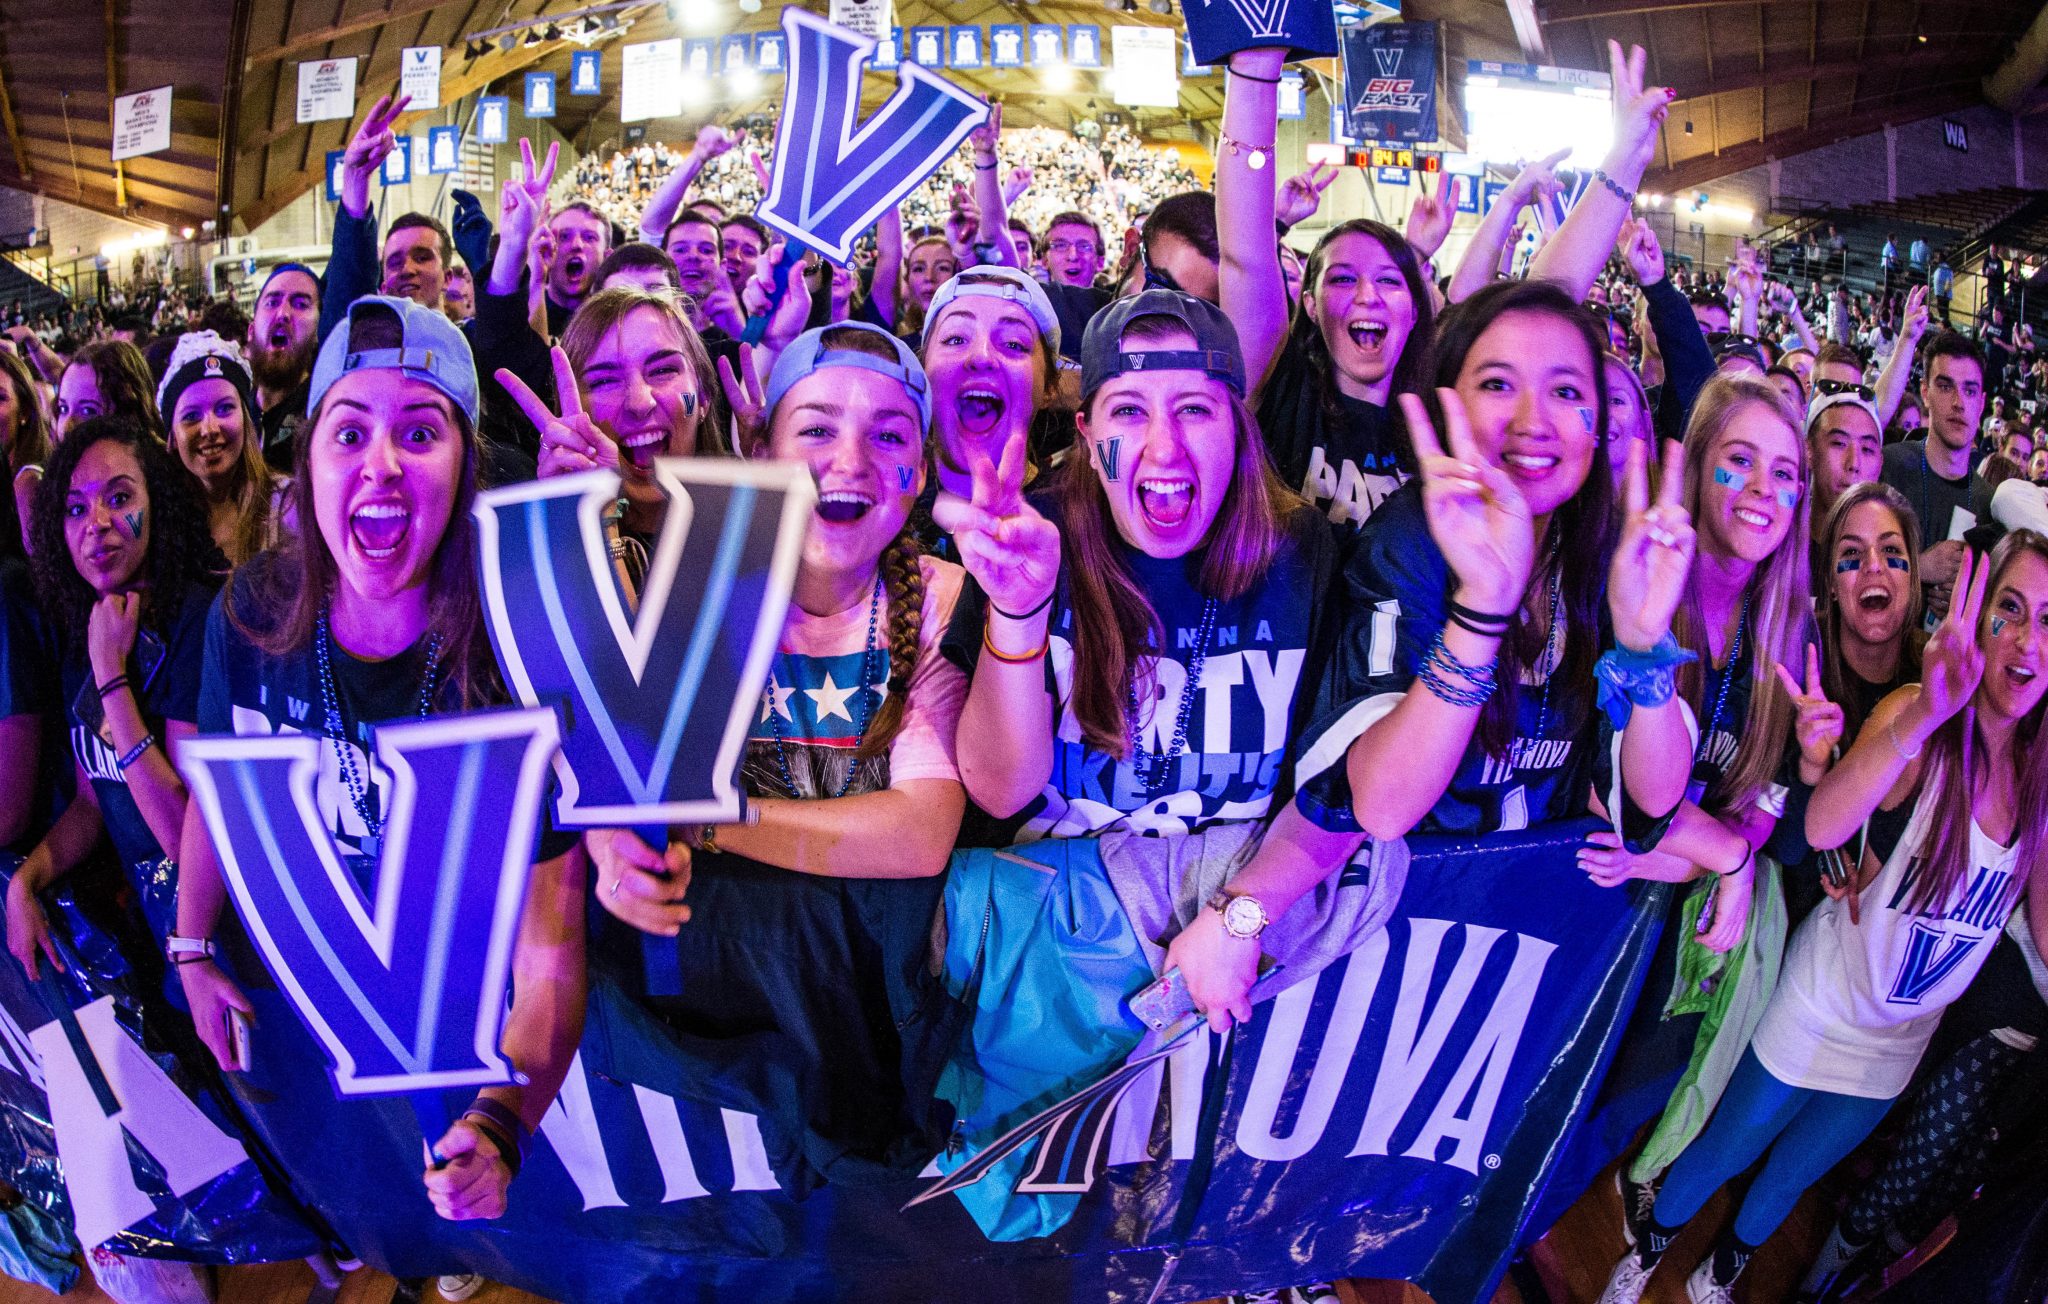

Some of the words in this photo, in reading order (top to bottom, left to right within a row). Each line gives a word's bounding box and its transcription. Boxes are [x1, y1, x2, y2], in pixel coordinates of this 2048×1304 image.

[415, 51, 428, 63] V
[1373, 48, 1403, 77] V
[1358, 93, 1428, 107] EAST
[1366, 79, 1414, 94] BIG
[756, 5, 991, 268] V
[1944, 121, 1968, 150] WA
[1357, 152, 1367, 167] 0
[1427, 157, 1438, 172] 0
[1129, 354, 1145, 370] V
[680, 393, 697, 417] V
[1096, 435, 1124, 482] V
[896, 464, 914, 491] V
[1301, 446, 1413, 529] PAR
[1723, 472, 1733, 484] V
[125, 511, 144, 539] V
[1991, 614, 2008, 638] V
[472, 458, 818, 831] V
[1049, 633, 1307, 757] PRTY
[178, 706, 562, 1098] V
[1886, 921, 1985, 1006] V
